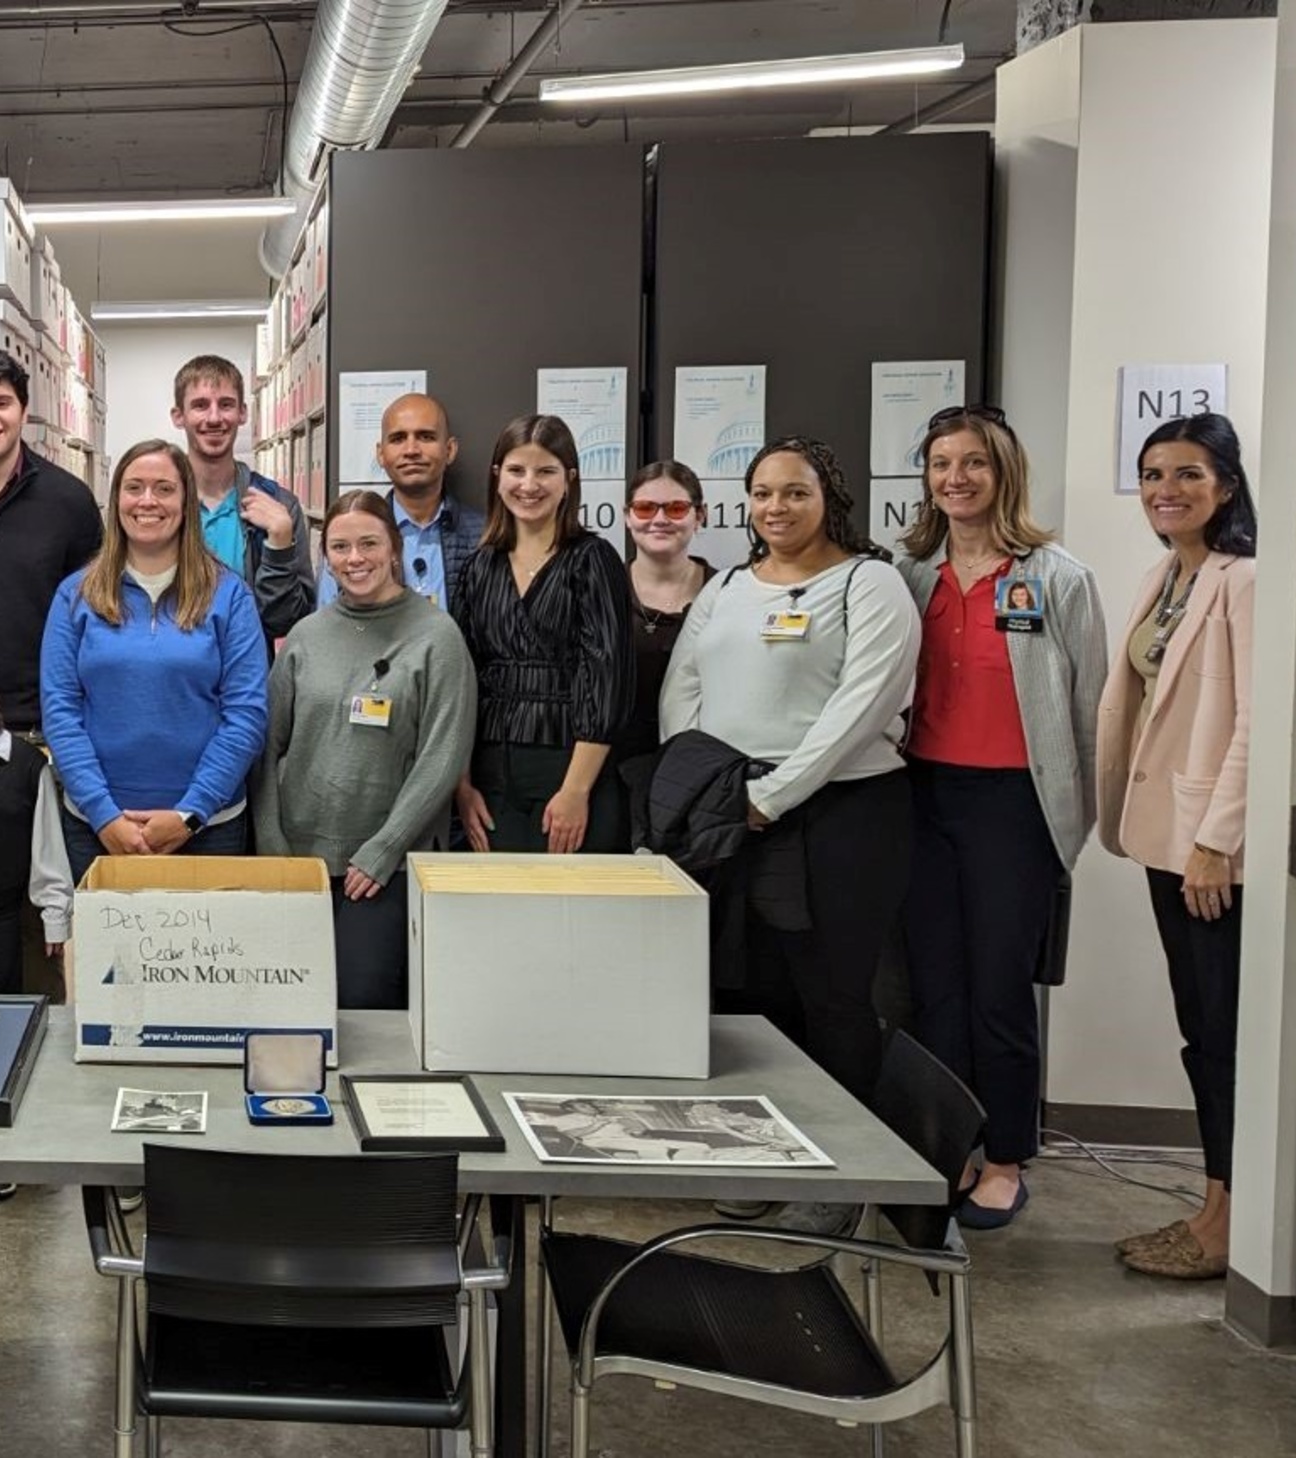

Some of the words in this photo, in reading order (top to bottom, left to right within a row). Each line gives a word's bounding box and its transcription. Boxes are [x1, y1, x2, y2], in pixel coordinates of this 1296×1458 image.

[1138, 388, 1211, 419] N13
[580, 502, 615, 529] 10
[701, 502, 749, 529] 11
[156, 908, 212, 932] 2014
[191, 936, 245, 961] Rapids
[142, 964, 190, 984] IRON
